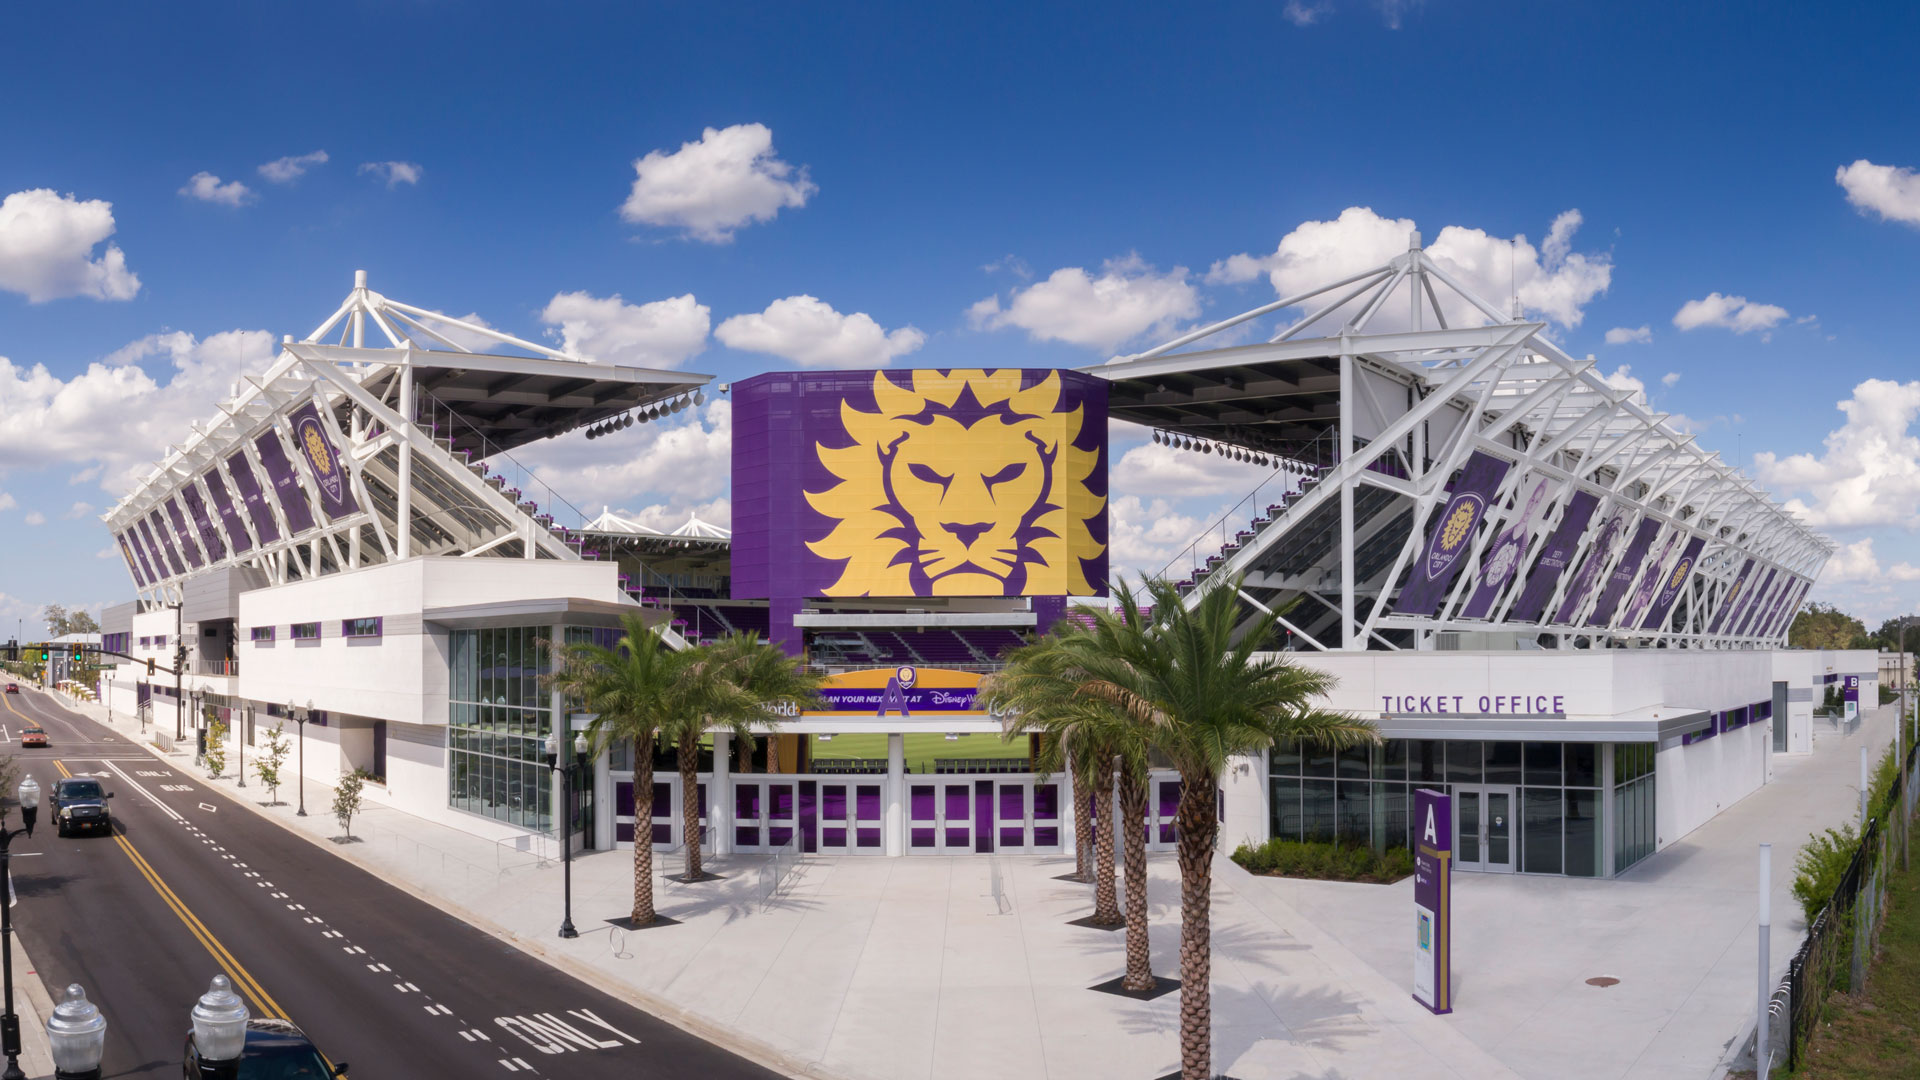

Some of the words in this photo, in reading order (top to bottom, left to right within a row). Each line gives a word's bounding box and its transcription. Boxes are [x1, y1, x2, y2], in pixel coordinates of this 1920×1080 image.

[1431, 552, 1453, 562] ORLANDO
[1432, 560, 1444, 568] CITY
[1851, 677, 1858, 687] B
[842, 695, 865, 703] YOUR
[866, 695, 883, 703] NEX
[910, 695, 922, 703] AT
[1382, 696, 1463, 713] TICKET
[1478, 696, 1564, 713] OFFICE
[159, 784, 194, 792] BUS
[1424, 803, 1437, 845] A
[494, 1008, 642, 1054] ONLY
